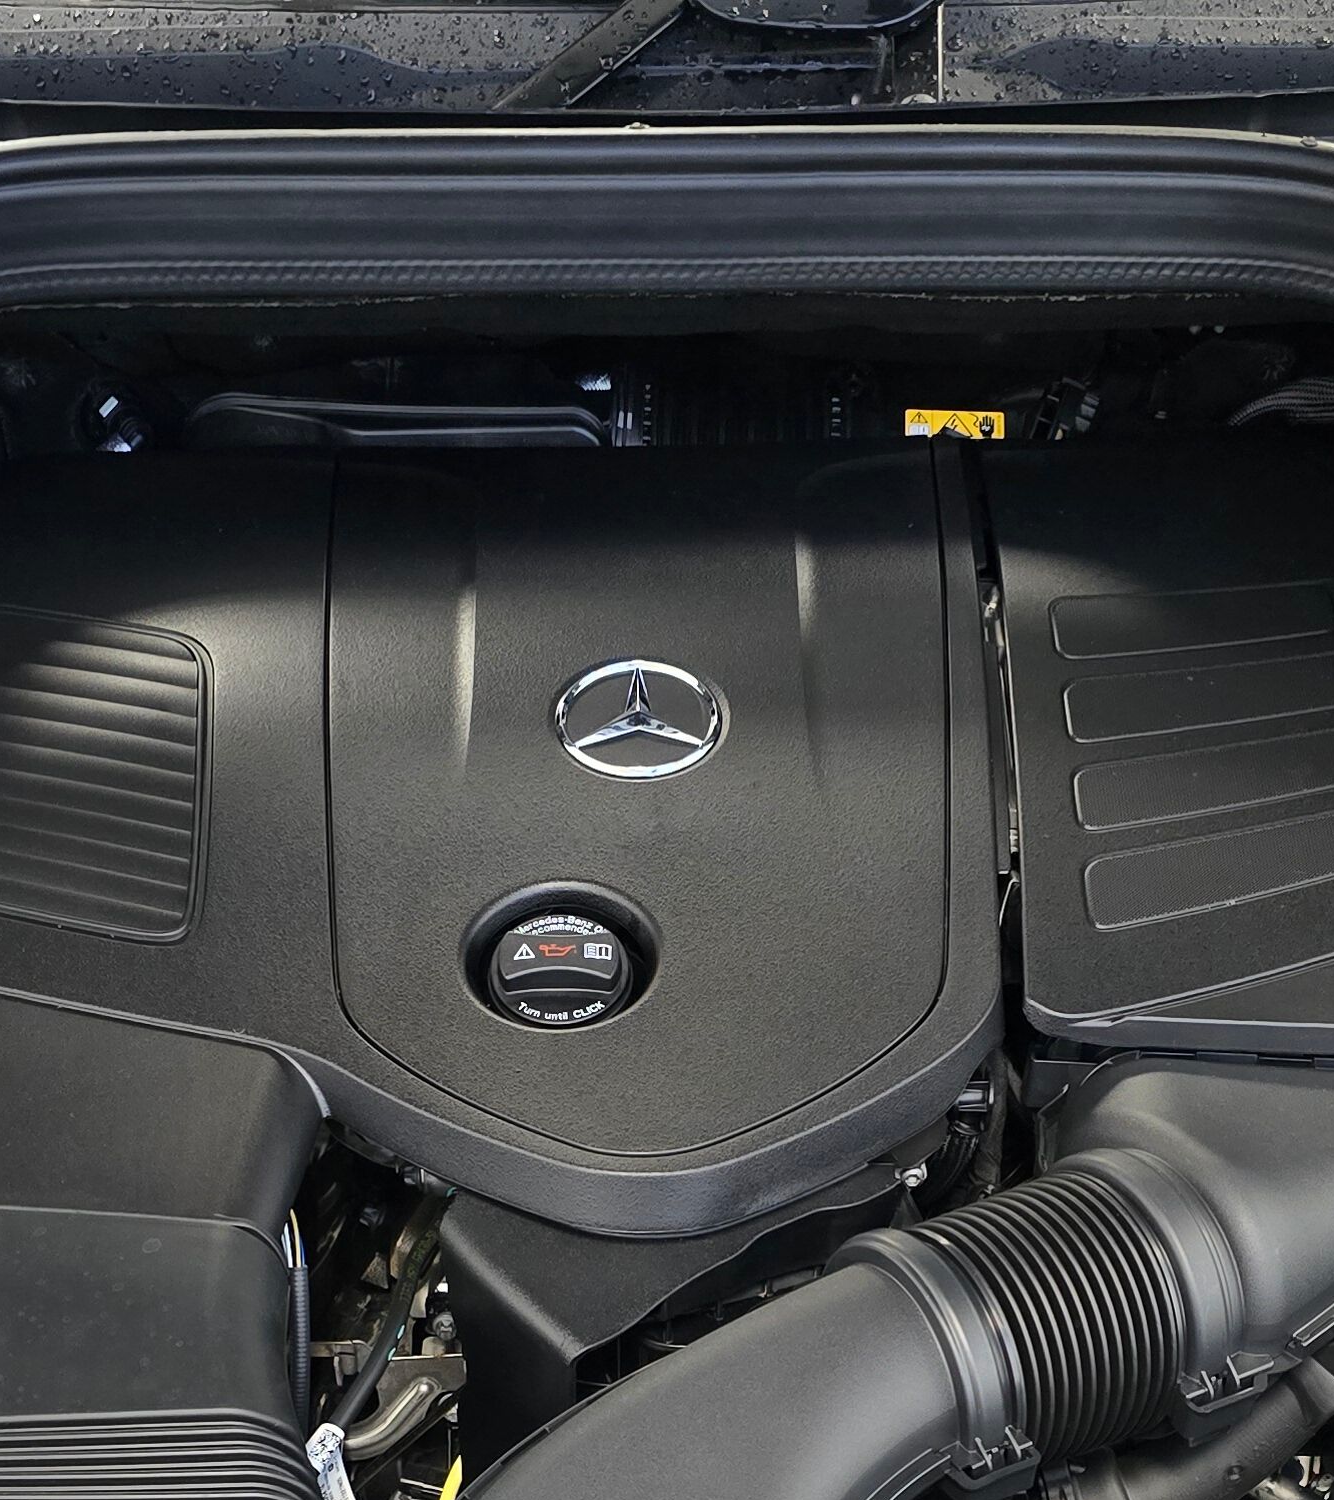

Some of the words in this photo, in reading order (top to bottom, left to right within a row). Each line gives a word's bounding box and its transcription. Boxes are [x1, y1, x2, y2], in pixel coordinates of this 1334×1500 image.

[518, 1001, 541, 1018] Turn
[544, 1010, 569, 1020] until
[572, 1000, 606, 1019] CLICK
